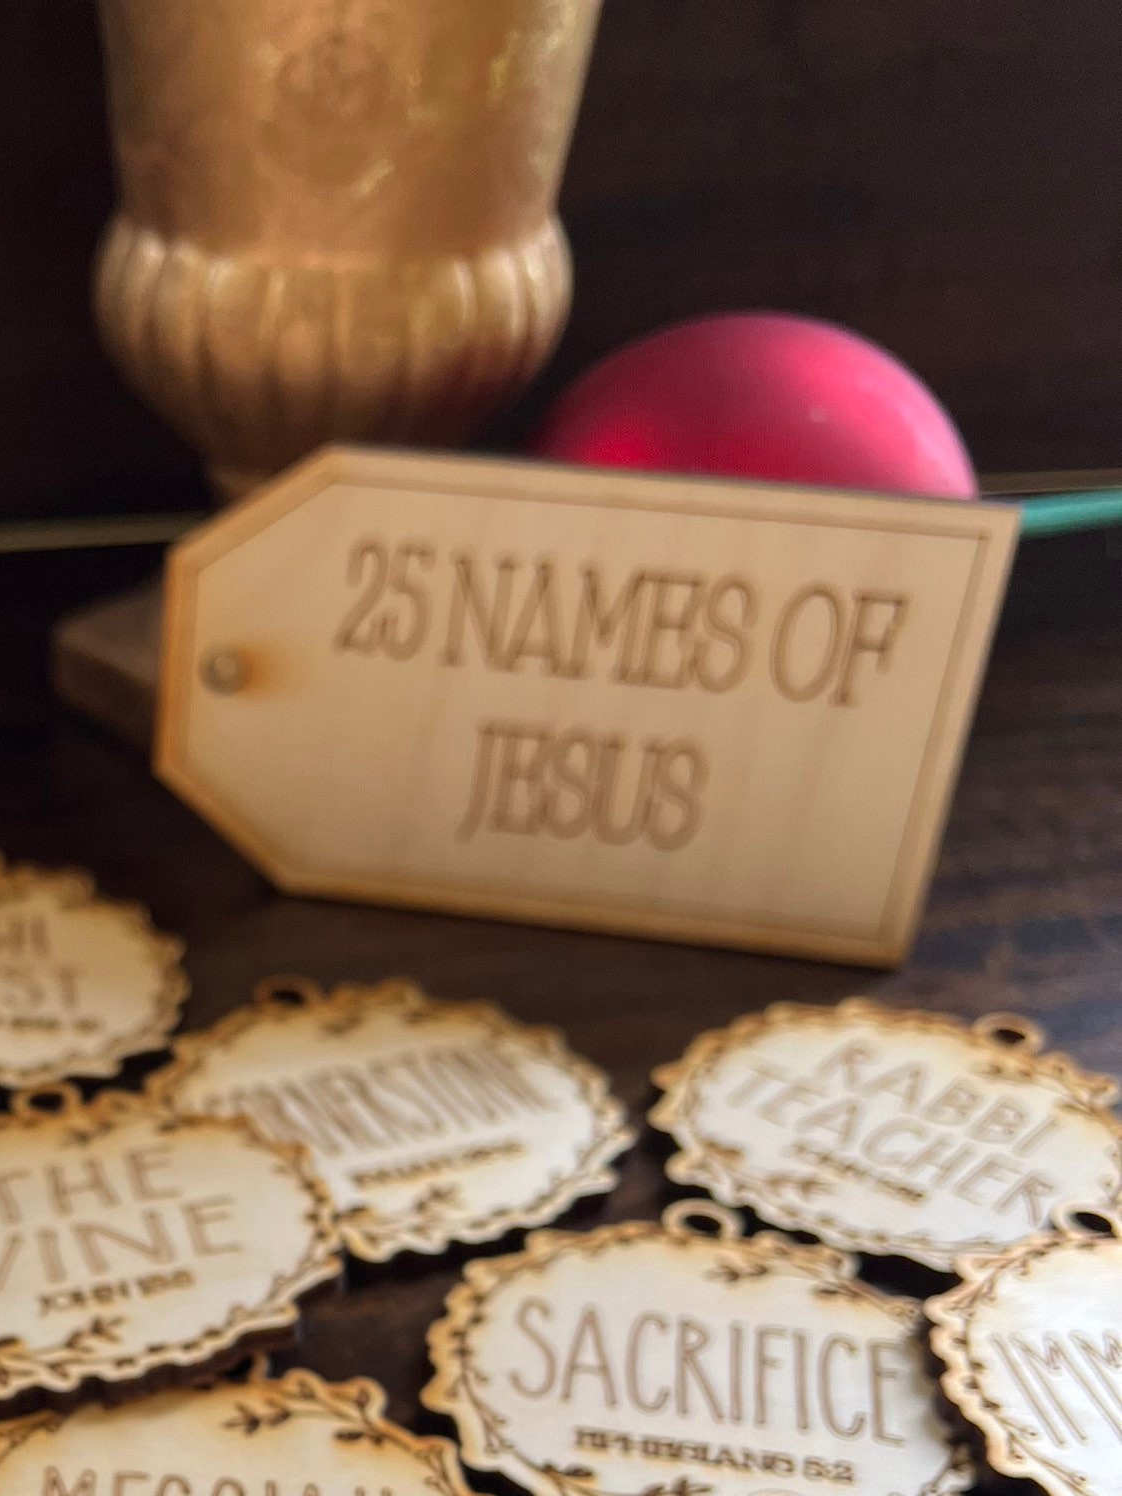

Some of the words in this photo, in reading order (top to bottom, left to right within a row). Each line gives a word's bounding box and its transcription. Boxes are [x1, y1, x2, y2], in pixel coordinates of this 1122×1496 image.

[334, 536, 436, 663] 25
[439, 554, 756, 695] NAMES
[769, 582, 906, 708] OF
[454, 718, 709, 851] JESUS
[725, 1060, 1056, 1227] TEACHER
[811, 1037, 1060, 1158] RABBI
[508, 1295, 907, 1447] SACRIFICE
